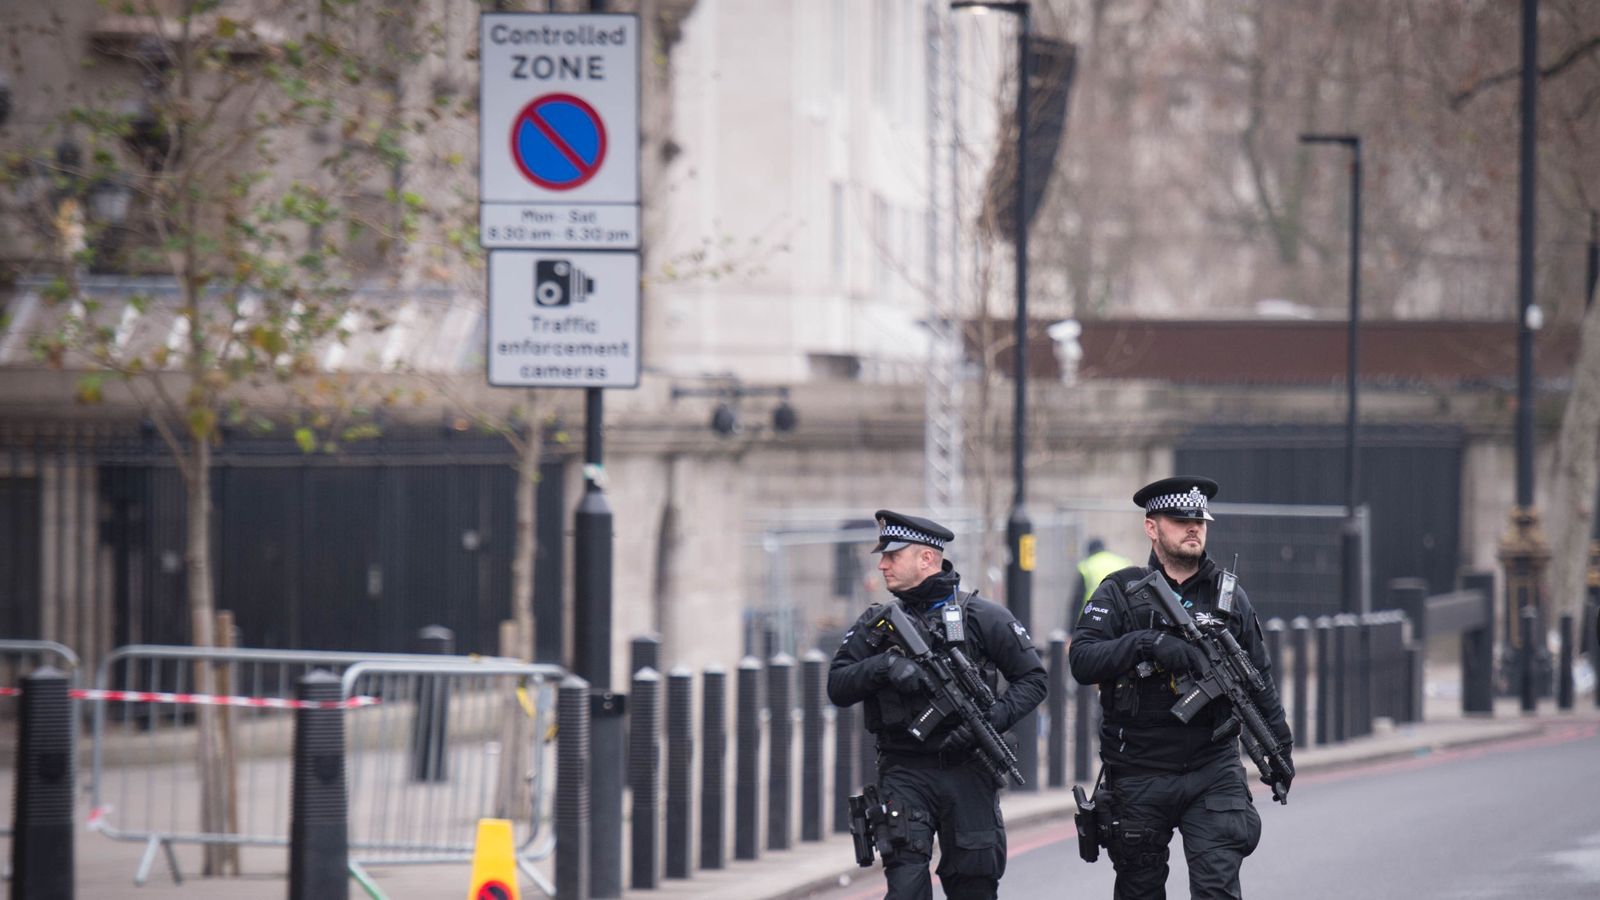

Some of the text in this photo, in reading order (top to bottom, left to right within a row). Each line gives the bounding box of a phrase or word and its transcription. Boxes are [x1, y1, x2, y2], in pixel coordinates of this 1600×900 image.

[490, 24, 626, 46] Controlled
[511, 54, 605, 80] ZONE
[521, 209, 555, 224] Mon
[568, 209, 598, 224] Sat
[487, 225, 527, 241] 8.30
[530, 229, 553, 241] am
[606, 229, 631, 243] pm
[530, 315, 599, 334] Traffic
[498, 338, 629, 357] enforcement
[519, 364, 608, 380] cameras
